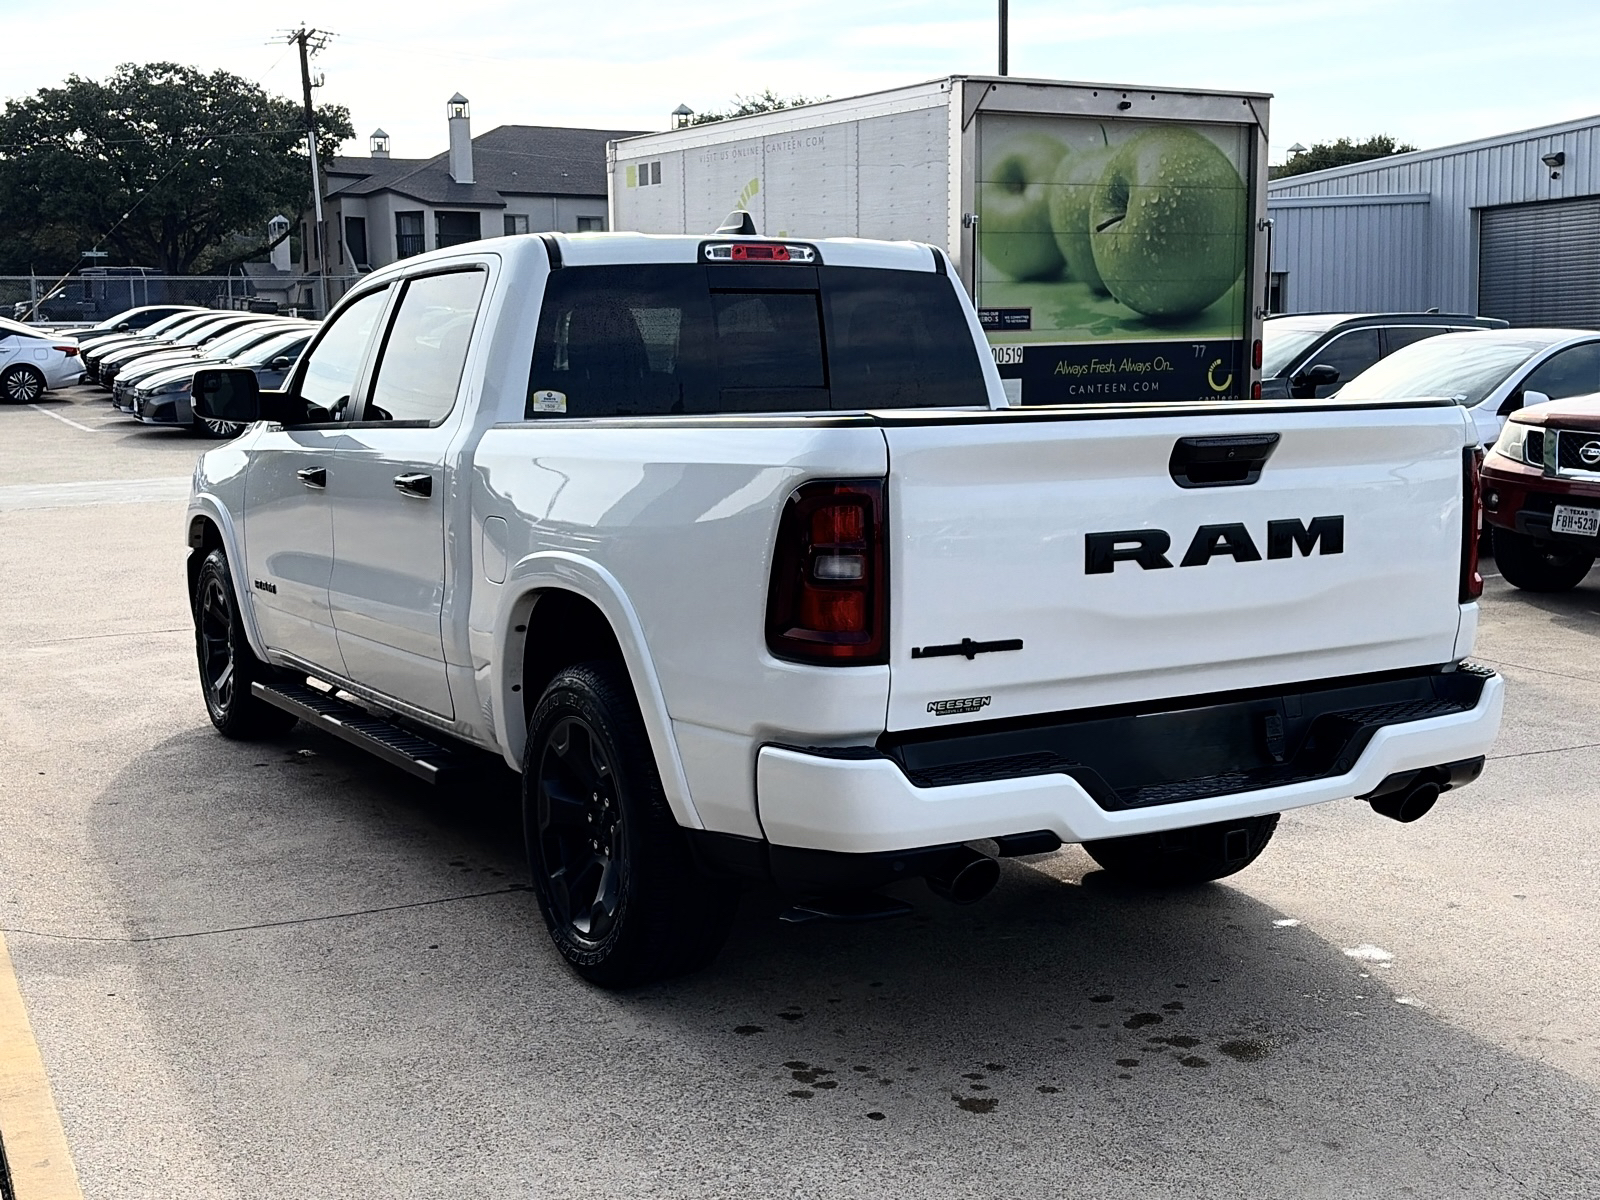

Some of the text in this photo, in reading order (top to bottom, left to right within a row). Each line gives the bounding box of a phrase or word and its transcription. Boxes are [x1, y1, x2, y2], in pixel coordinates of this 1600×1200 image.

[720, 150, 729, 160] US
[732, 146, 759, 158] ONLINE
[1192, 345, 1206, 358] 77
[1053, 360, 1088, 378] Always
[1090, 358, 1116, 373] Fresh,
[1118, 357, 1152, 375] Always
[1069, 381, 1159, 395] CANTEEN.COM
[1084, 515, 1344, 575] RAM
[927, 696, 991, 712] NEESSEN
